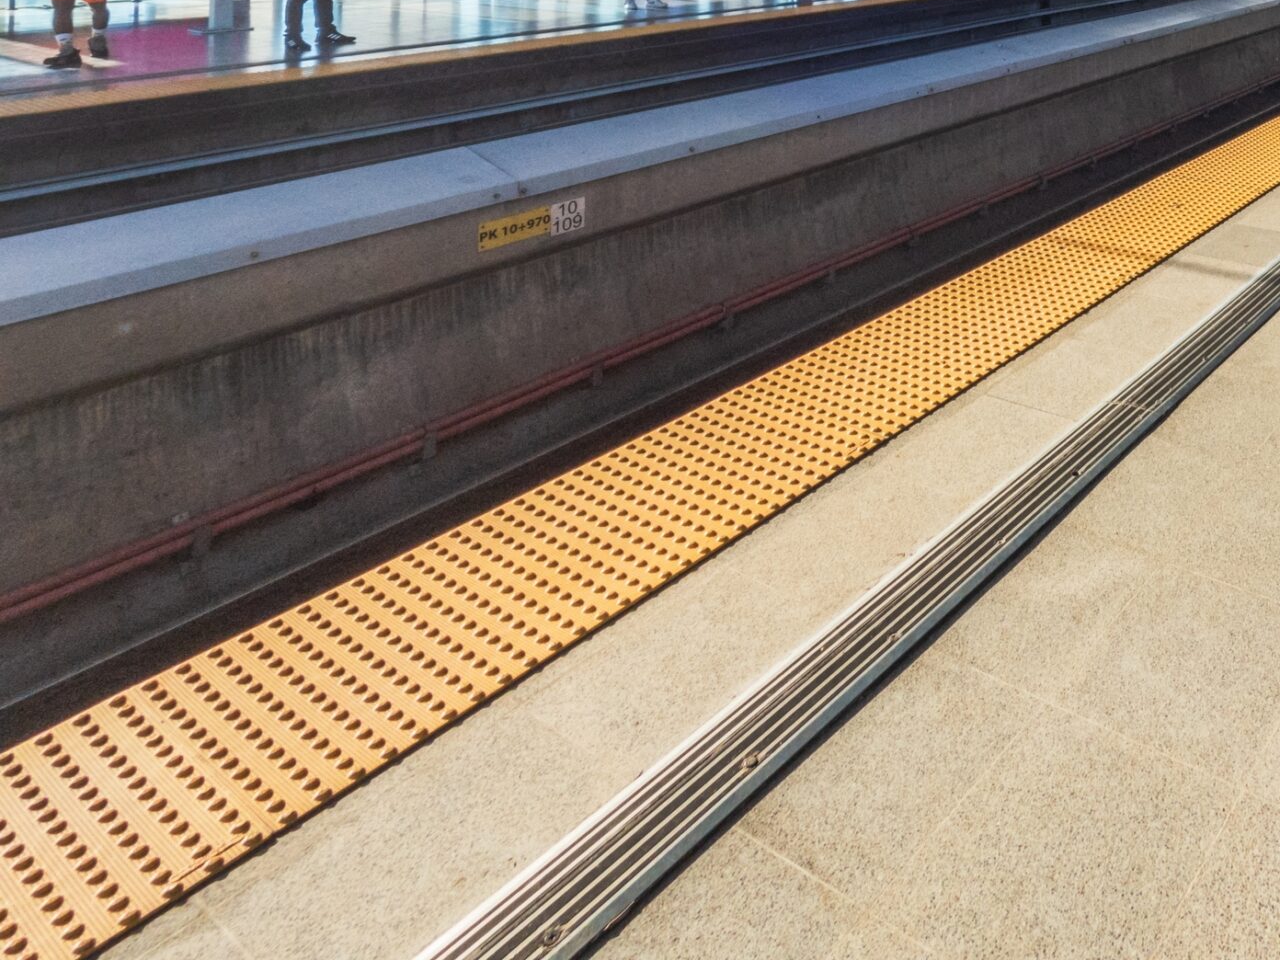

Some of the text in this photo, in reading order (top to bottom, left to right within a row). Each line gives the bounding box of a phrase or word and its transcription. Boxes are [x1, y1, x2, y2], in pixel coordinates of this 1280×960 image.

[558, 200, 578, 217] 10
[479, 214, 552, 243] PK 10+970
[552, 213, 583, 233] 109
